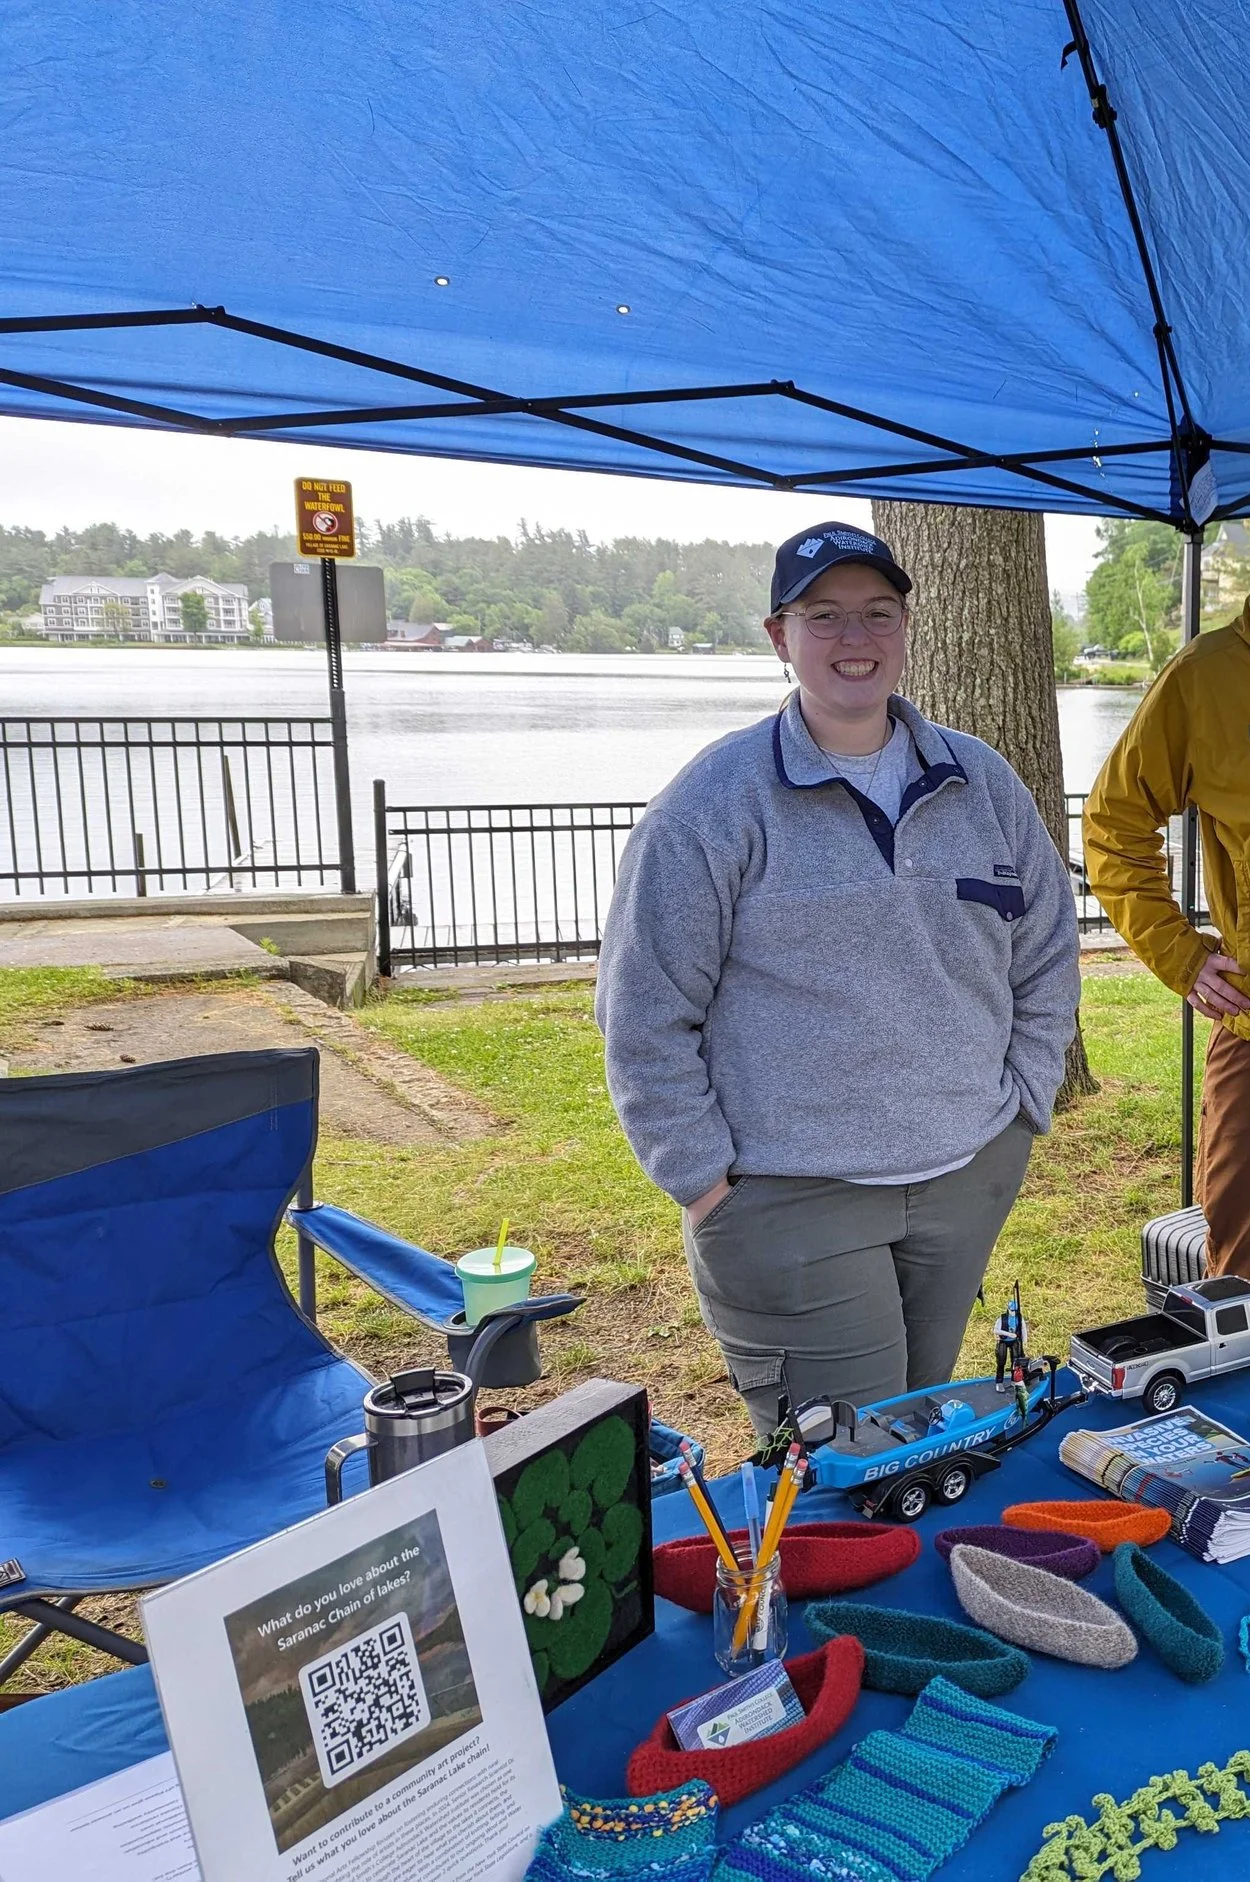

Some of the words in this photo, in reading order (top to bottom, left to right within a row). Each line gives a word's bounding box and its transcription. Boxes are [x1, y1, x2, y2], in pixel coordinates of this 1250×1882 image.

[314, 482, 327, 491] NOT
[329, 483, 345, 493] FEED
[318, 492, 331, 501] THE
[304, 501, 345, 512] WATERFOWL
[1104, 1415, 1187, 1443] INVASIVE
[1113, 1427, 1188, 1450] SPECIES
[863, 1457, 899, 1481] BIG
[905, 1426, 997, 1468] COUNTRY
[1125, 1446, 1149, 1458] IN
[1149, 1435, 1202, 1455] YOUR
[1142, 1441, 1212, 1464] WATERS
[256, 1610, 293, 1638] What
[293, 1600, 312, 1619] do
[313, 1589, 338, 1612] you
[338, 1573, 364, 1596] love
[363, 1555, 399, 1581] about
[400, 1543, 420, 1562] the
[276, 1617, 327, 1652] Saranac
[326, 1598, 361, 1624] Chain
[361, 1588, 376, 1605] of
[376, 1569, 412, 1597] lakes?
[753, 1692, 774, 1706] COLLEGE
[734, 1702, 773, 1725] ADIRONDACK
[738, 1708, 773, 1730] WATERSHED
[743, 1716, 774, 1734] INSTITUTE
[292, 1845, 316, 1866] Want
[318, 1837, 328, 1849] to
[328, 1806, 373, 1842] contribute
[374, 1800, 384, 1811] to
[390, 1765, 436, 1802] community
[436, 1757, 448, 1770] art
[448, 1734, 481, 1763] project?
[287, 1868, 303, 1882] Tell
[304, 1862, 315, 1874] us
[316, 1845, 339, 1865] what
[340, 1834, 357, 1851] you
[357, 1819, 376, 1838] love
[376, 1802, 401, 1825] about
[401, 1792, 416, 1807] the
[416, 1771, 447, 1798] Saranac
[447, 1759, 466, 1776] Lake
[466, 1743, 490, 1764] chain!
[375, 1849, 395, 1866] College
[395, 1829, 422, 1851] Adirondack
[423, 1810, 450, 1831] Watershed
[416, 1835, 427, 1846] Lake
[347, 1842, 376, 1866] Fellowship
